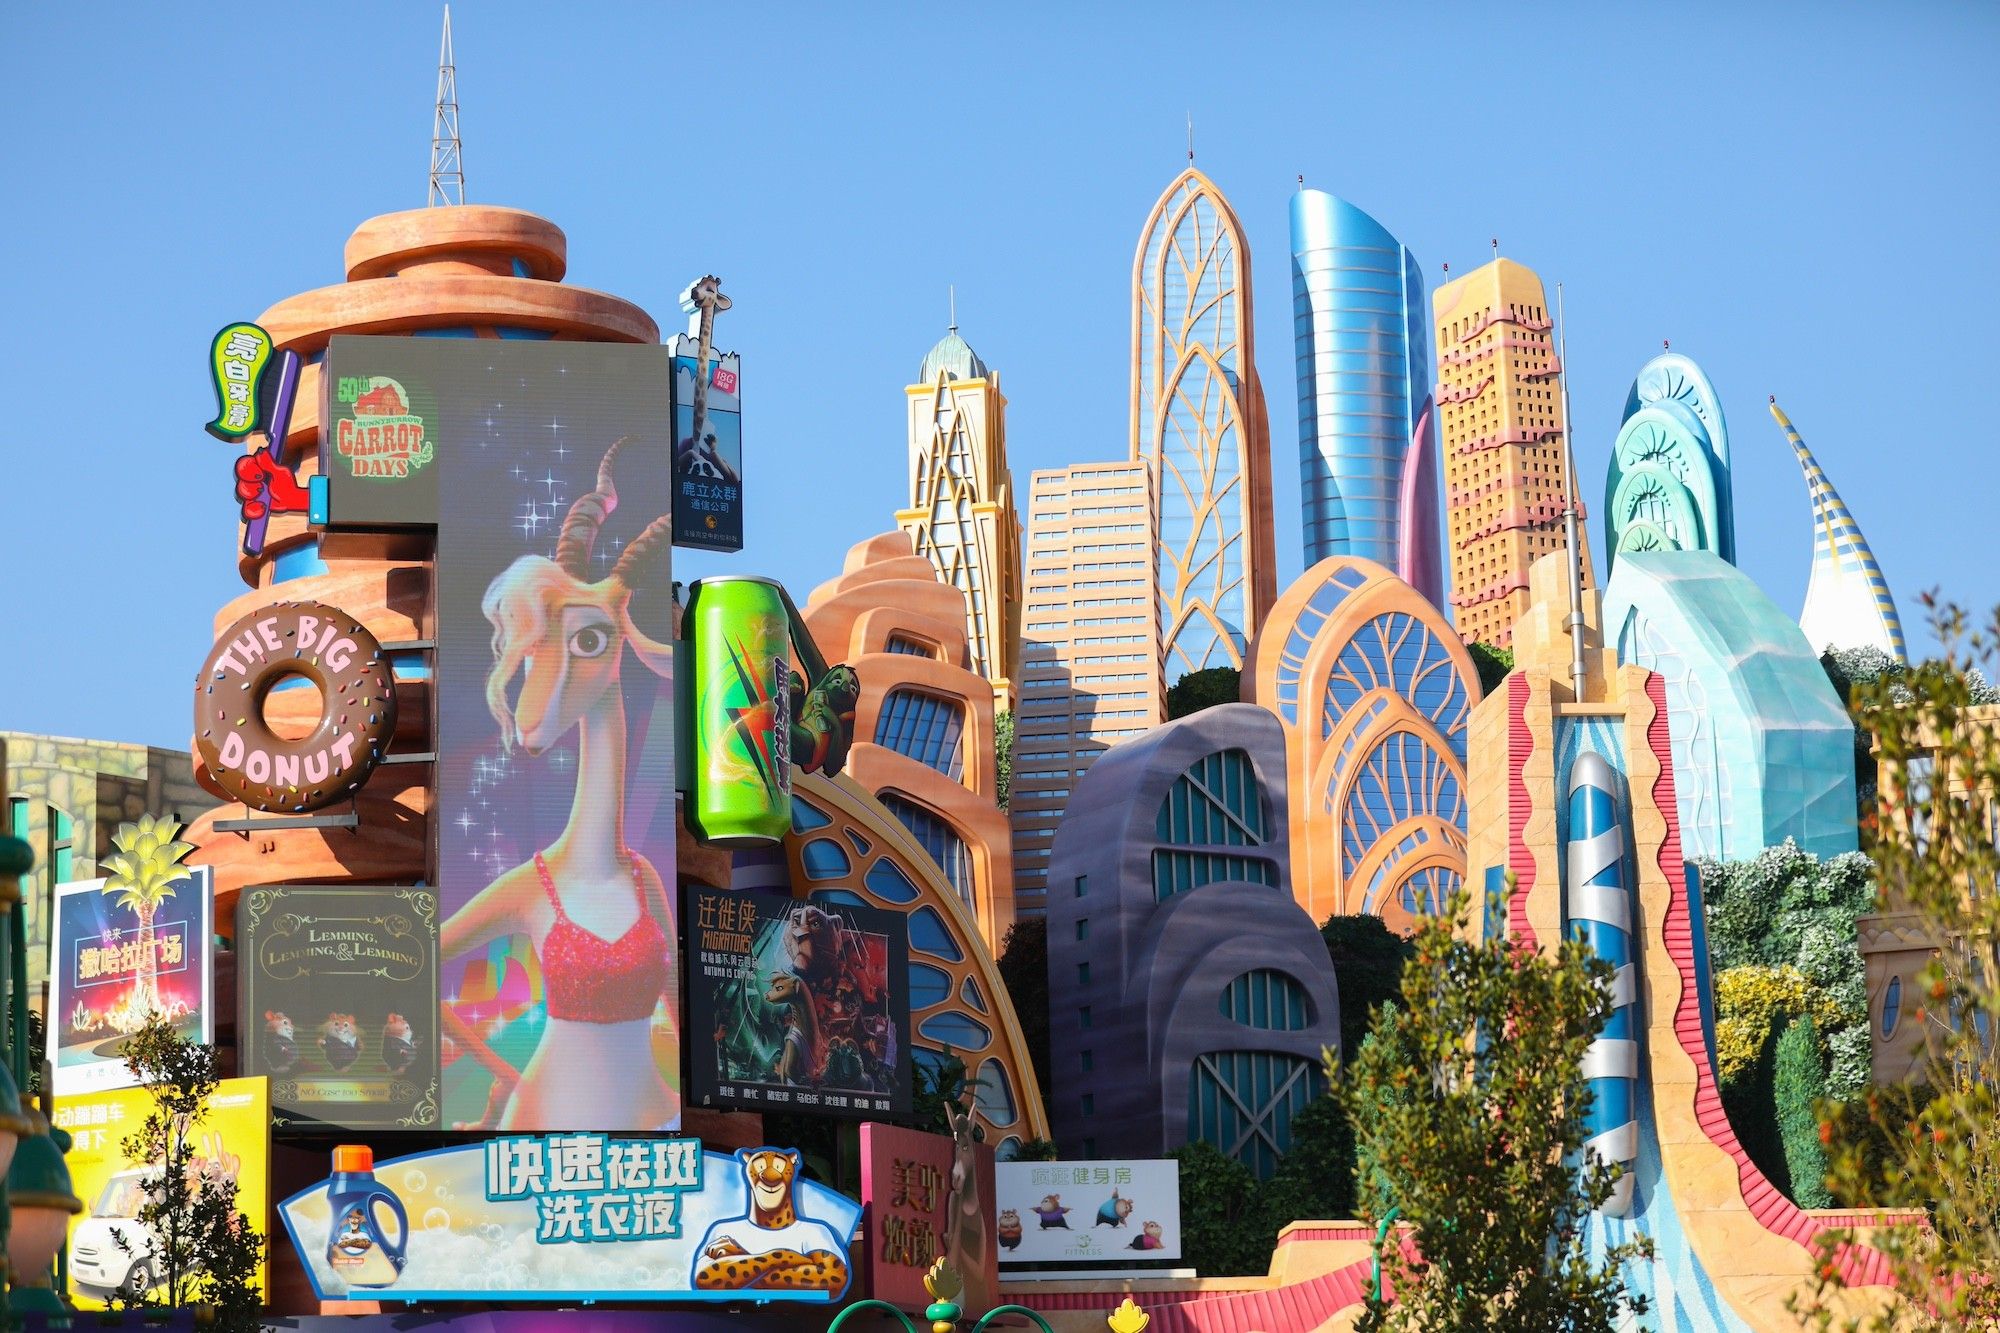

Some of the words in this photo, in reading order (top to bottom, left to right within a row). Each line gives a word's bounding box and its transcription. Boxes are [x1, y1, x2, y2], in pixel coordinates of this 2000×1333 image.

[224, 332, 263, 427] 亮白牙膏
[717, 371, 734, 384] 18G
[338, 376, 370, 403] 50th
[357, 416, 422, 427] BUNNYBURROW
[339, 420, 424, 456] CARROT
[354, 459, 408, 476] DAYS
[682, 481, 737, 502] 鹿立众群
[690, 498, 729, 513] 通信公司
[213, 617, 283, 676] THE
[297, 615, 358, 673] BIG
[219, 731, 355, 786] DONUT
[697, 893, 756, 933] 迁徙侠
[102, 927, 122, 942] 快来
[701, 930, 752, 953] MIGRATORS
[79, 935, 183, 980] 撒哈拉广场
[336, 943, 355, 961] &
[726, 968, 733, 978] IS
[796, 1092, 820, 1105] 马伯乐
[488, 1135, 698, 1195] 快速祛斑
[1031, 1167, 1132, 1186] 疯狂健身房
[541, 1191, 676, 1239] 洗衣液
[1065, 1248, 1102, 1256] FITNESS
